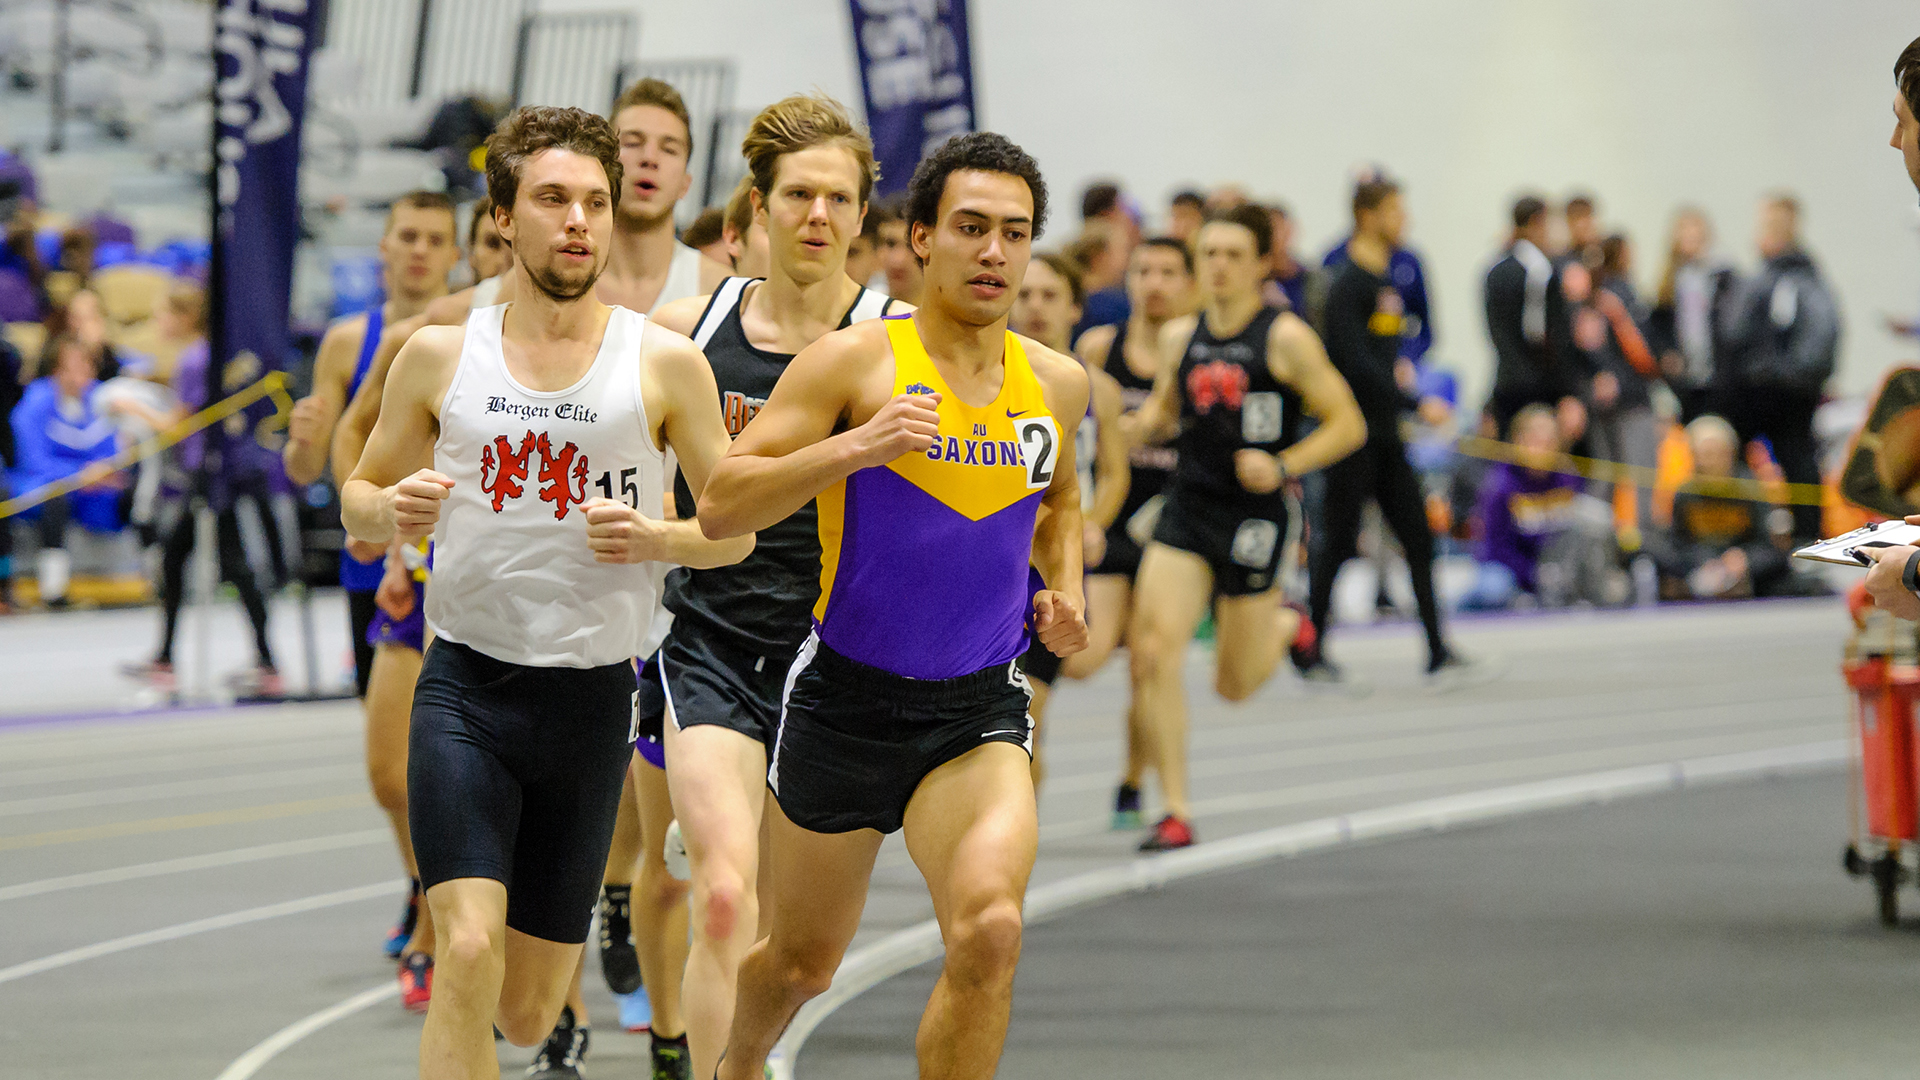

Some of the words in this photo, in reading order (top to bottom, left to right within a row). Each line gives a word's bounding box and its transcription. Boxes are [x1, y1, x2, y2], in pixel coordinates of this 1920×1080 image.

[485, 396, 549, 421] Bergen
[554, 403, 598, 423] Elite
[972, 423, 987, 436] AU
[1022, 423, 1053, 484] 2
[595, 467, 639, 511] 15
